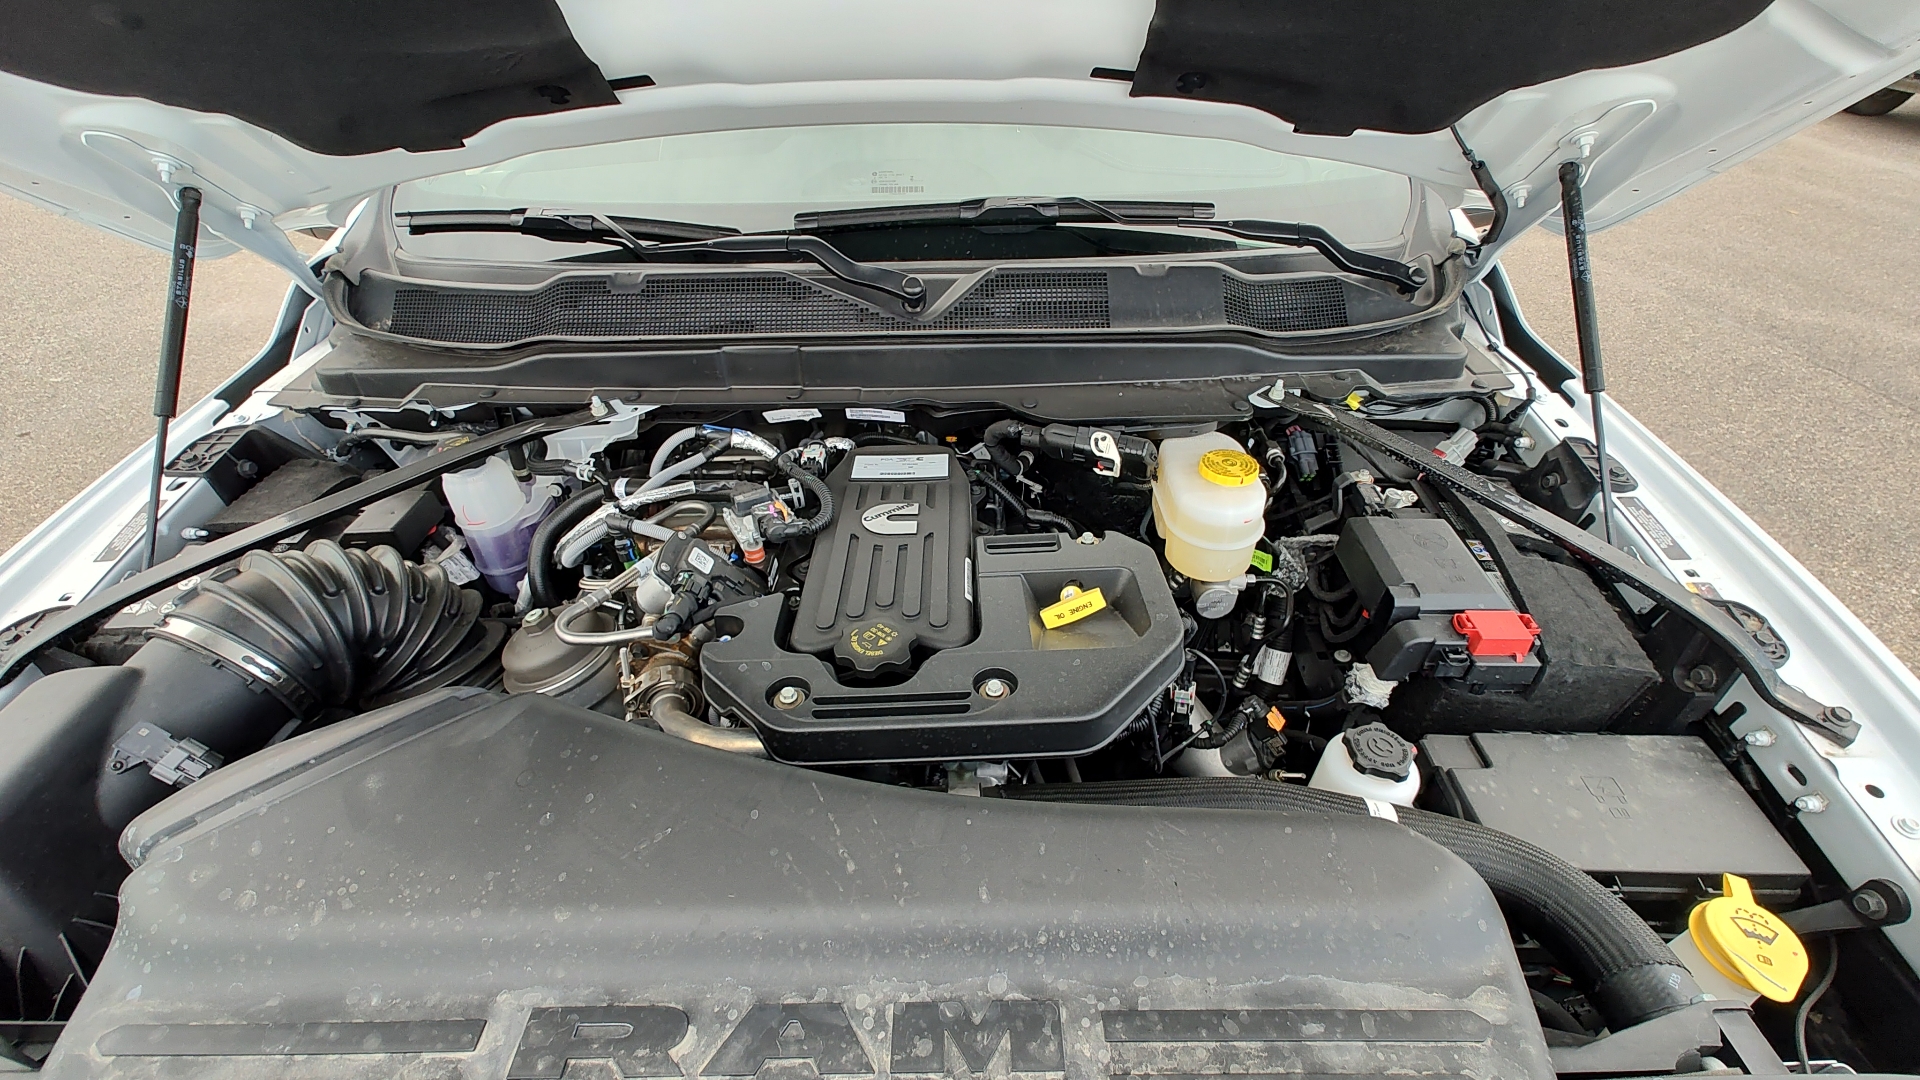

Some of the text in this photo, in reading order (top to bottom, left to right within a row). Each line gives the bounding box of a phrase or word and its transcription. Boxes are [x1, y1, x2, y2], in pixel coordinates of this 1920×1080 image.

[176, 259, 185, 295] STABILUS
[863, 503, 914, 521] Cummins
[1054, 601, 1093, 620] ENGINE OIL
[864, 649, 884, 657] DIESEL
[506, 1000, 1066, 1080] RAM
